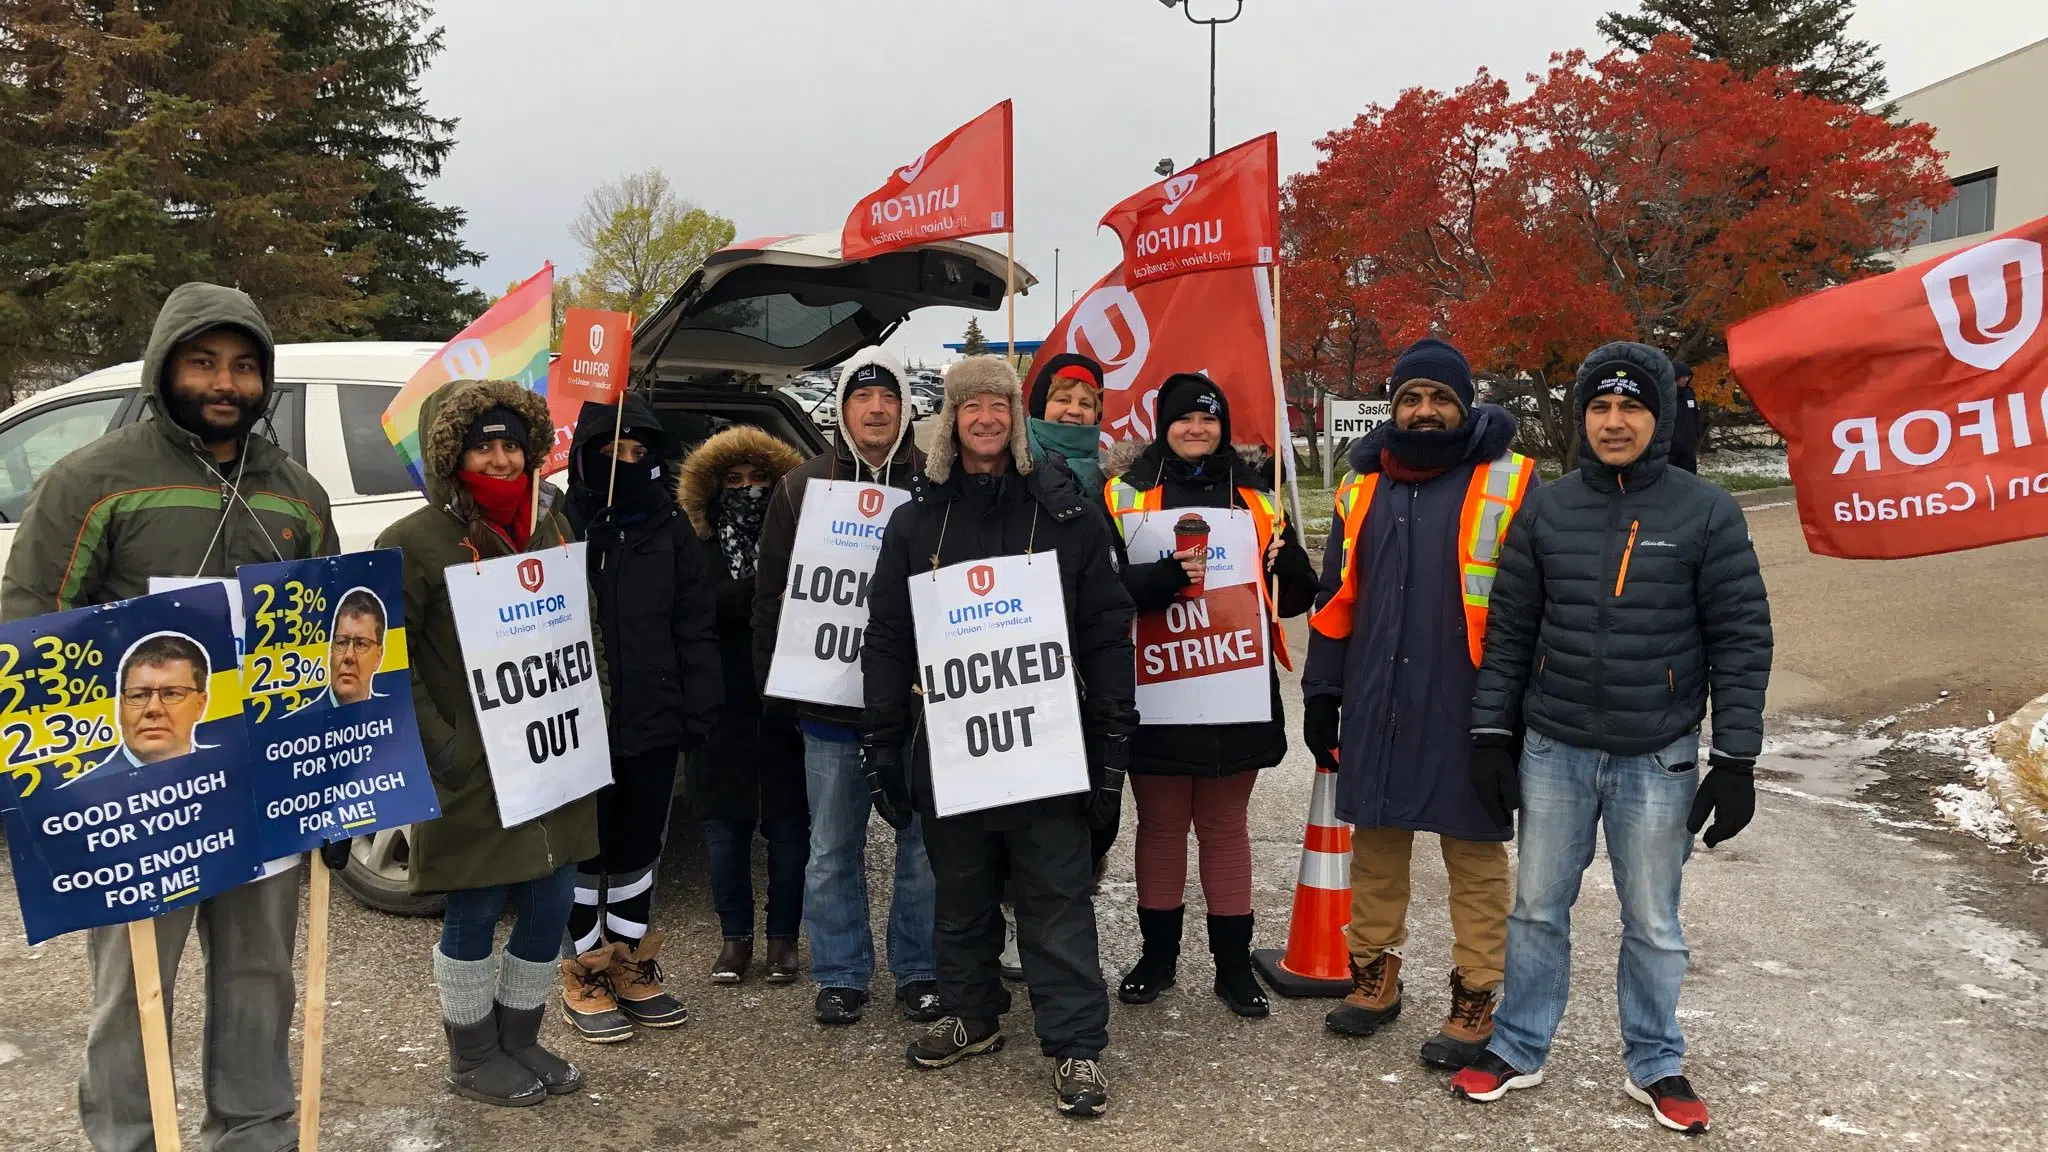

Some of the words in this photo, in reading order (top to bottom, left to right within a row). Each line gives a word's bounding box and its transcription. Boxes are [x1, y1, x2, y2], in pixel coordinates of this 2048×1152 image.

[253, 581, 326, 620] 2.3%
[791, 564, 873, 608] LOCK
[1166, 599, 1211, 634] ON
[814, 622, 861, 664] OU
[1144, 629, 1257, 675] STRIKE
[250, 651, 325, 694] 2.3%
[472, 640, 593, 712] LOCKED
[925, 641, 1066, 704] LOCKED
[2, 712, 114, 766] 2.3%
[266, 735, 320, 761] GOOD
[325, 718, 393, 749] ENOUGH
[525, 707, 580, 765] OUT
[966, 705, 1035, 758] OUT
[293, 756, 327, 779] FOR
[330, 745, 373, 770] YOU?
[42, 801, 122, 835] GOOD
[128, 770, 227, 815] ENOUGH
[266, 792, 320, 819] GOOD
[324, 771, 405, 805] ENOUGH
[299, 811, 335, 835] FOR
[338, 800, 376, 823] ME!
[87, 823, 137, 852] FOR
[140, 803, 203, 836] YOU?
[52, 862, 134, 893] GOOD
[139, 829, 235, 876] ENOUGH
[105, 882, 157, 908] FOR
[161, 865, 200, 896] ME!
